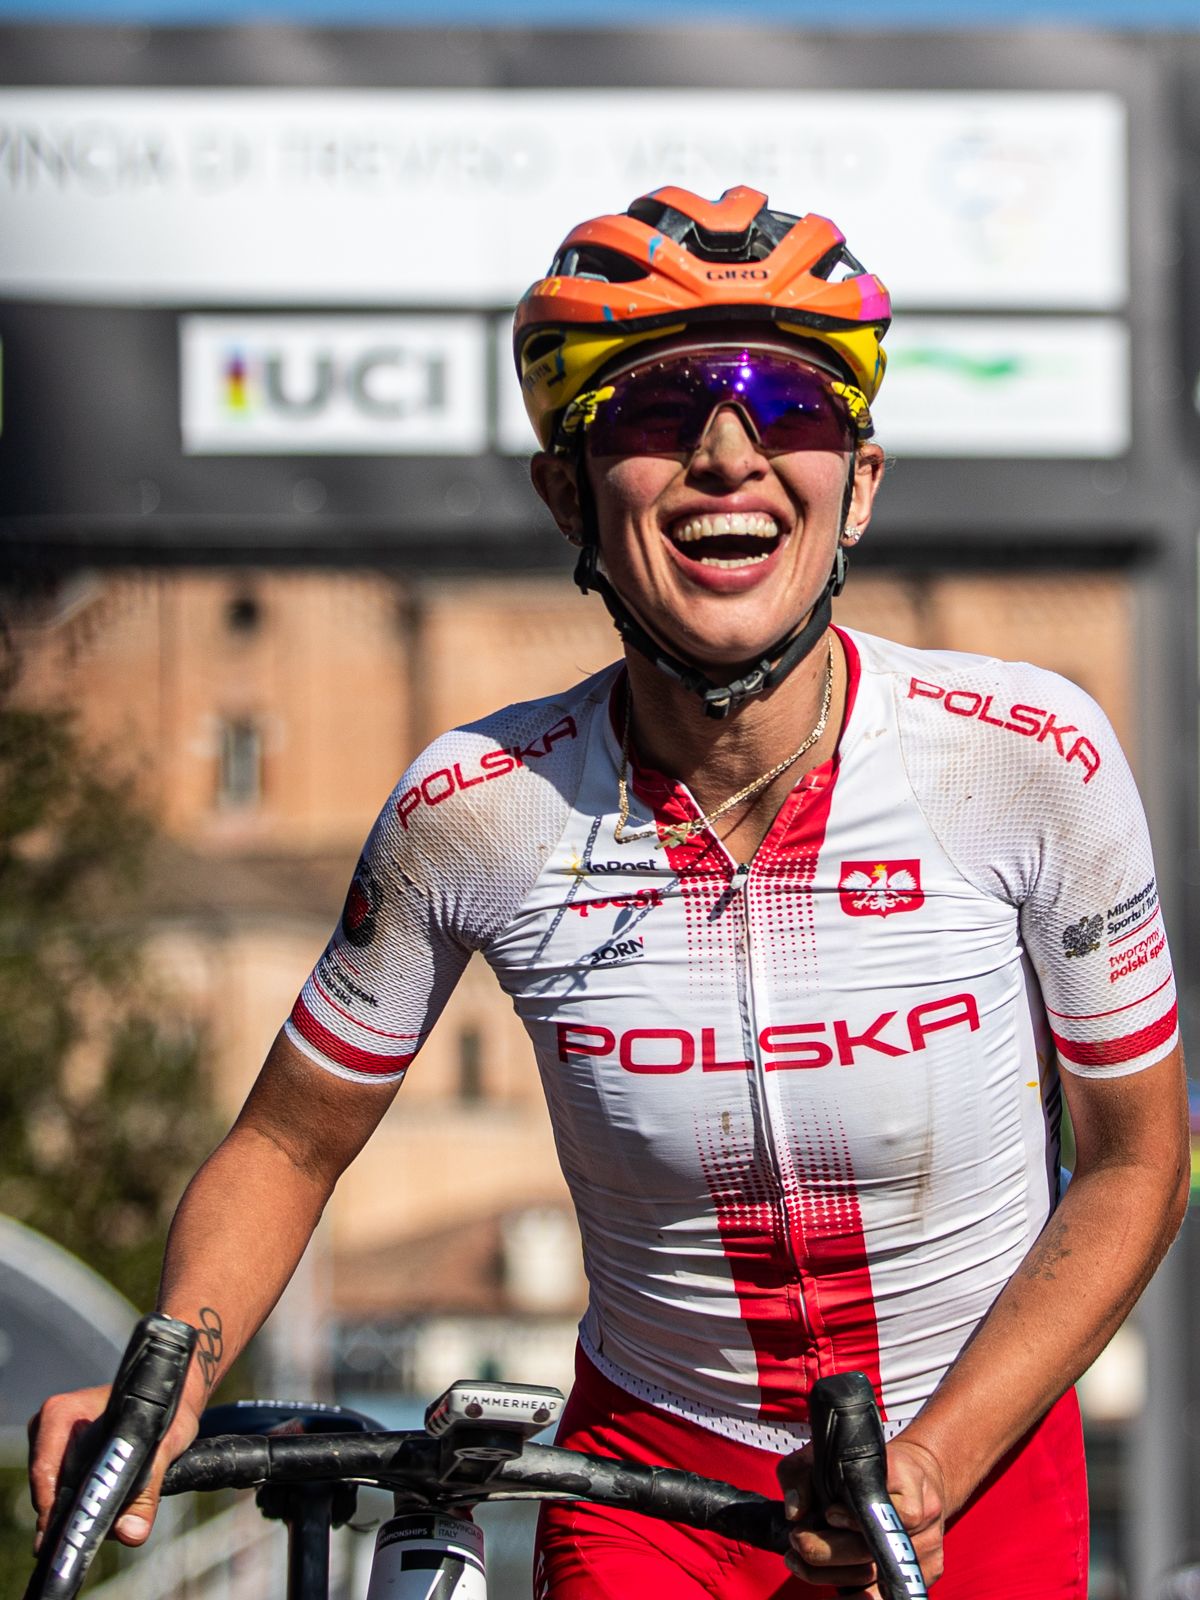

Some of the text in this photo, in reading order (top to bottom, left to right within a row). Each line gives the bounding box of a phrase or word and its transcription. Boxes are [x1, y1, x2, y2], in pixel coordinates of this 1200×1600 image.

[706, 268, 768, 281] GIRO
[263, 344, 446, 418] UCI
[907, 677, 1101, 784] POLSKA
[397, 715, 577, 830] POLSKA
[586, 859, 657, 874] InPost
[1107, 910, 1141, 935] Sportu
[591, 936, 644, 966] BORN
[1110, 951, 1148, 984] polski
[556, 993, 980, 1074] POLSKA
[461, 1394, 557, 1410] HAMMERHEAD
[52, 1437, 134, 1579] SRAM
[438, 1528, 458, 1538] ITALY
[869, 1503, 928, 1600] SRA
